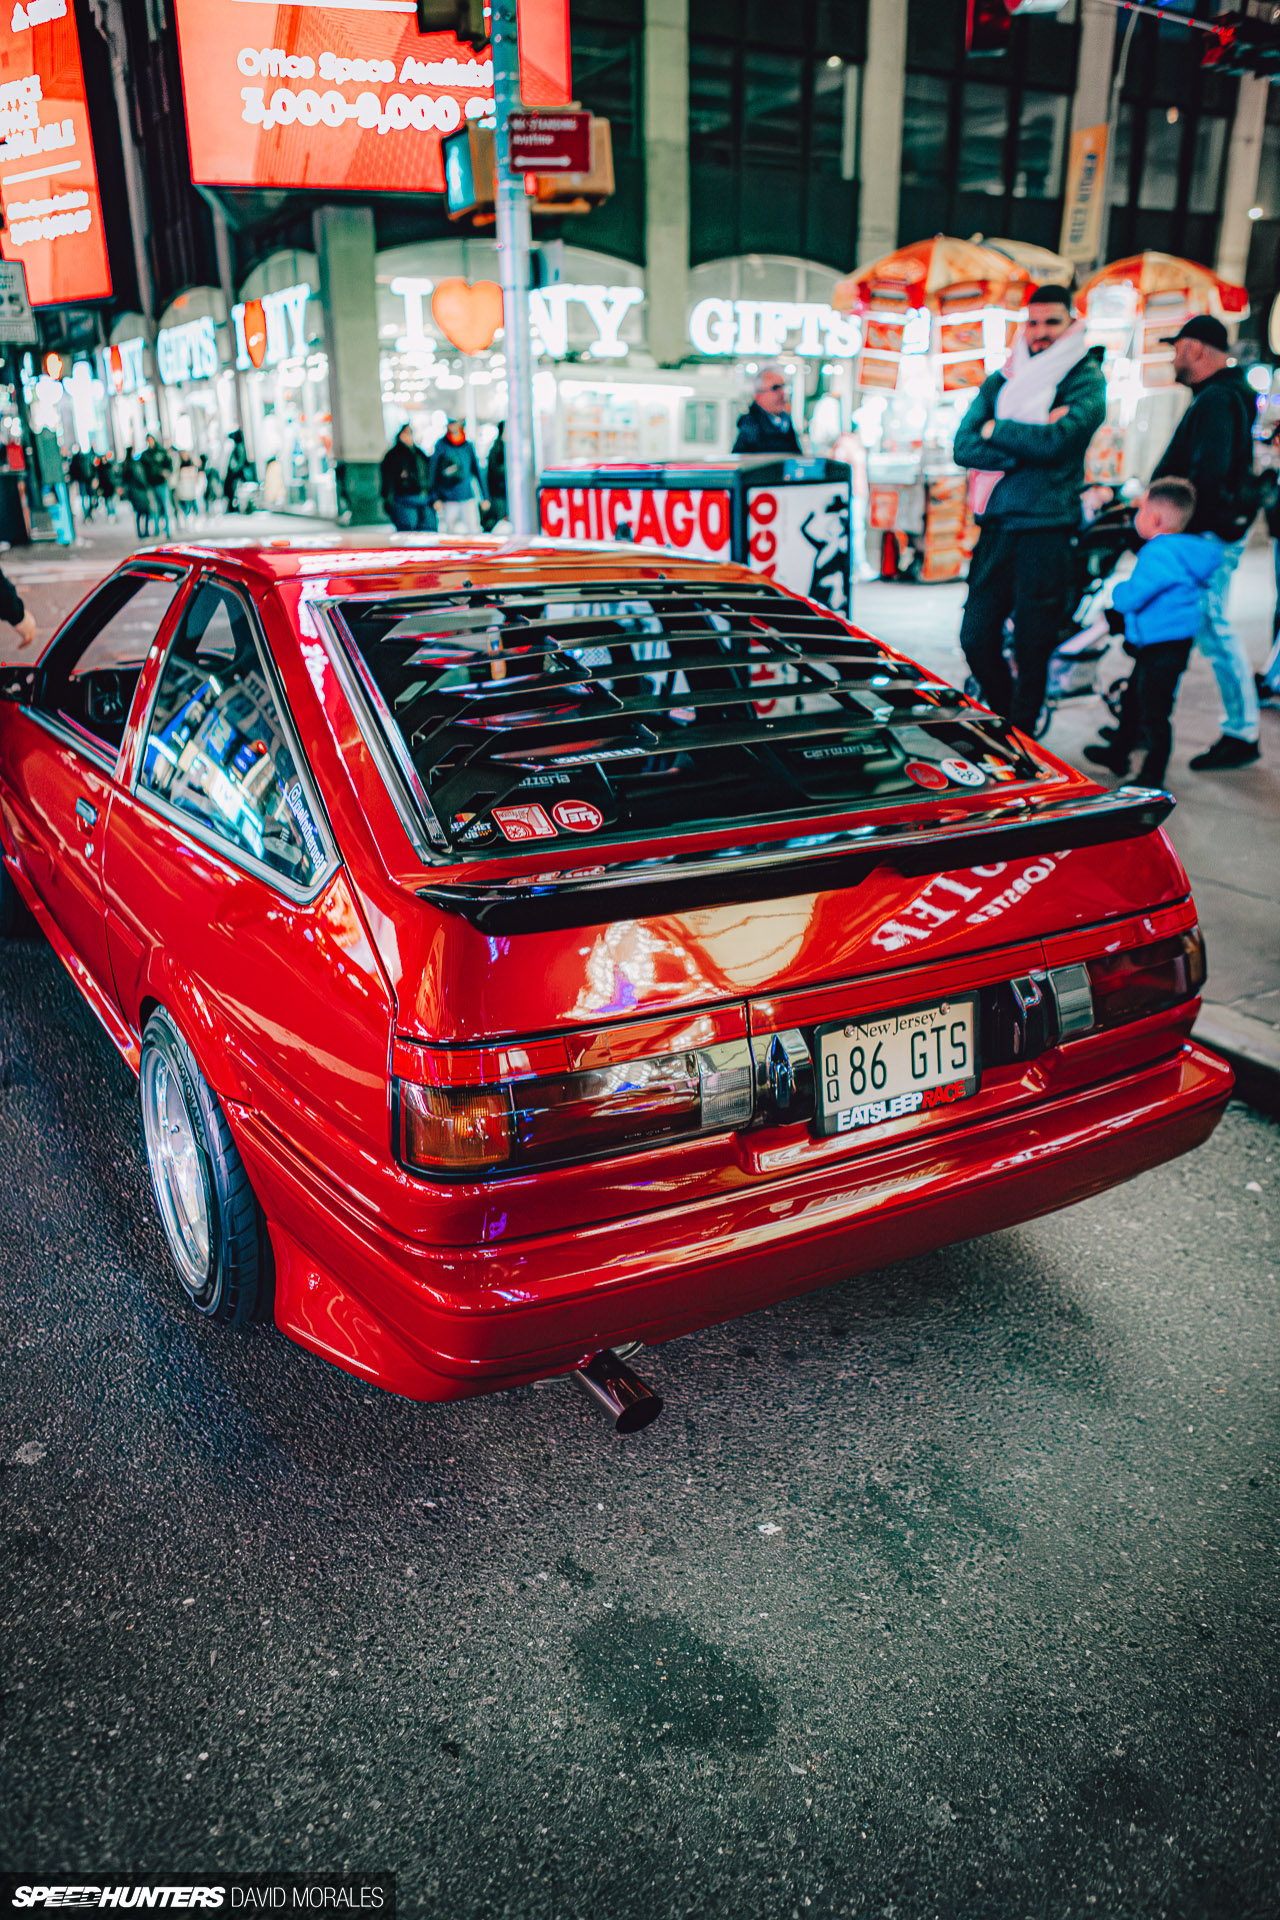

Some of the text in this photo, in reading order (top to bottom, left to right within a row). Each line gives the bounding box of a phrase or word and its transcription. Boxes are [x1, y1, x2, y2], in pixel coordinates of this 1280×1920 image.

[157, 315, 219, 386] GIFTS
[689, 298, 863, 358] GIFTS
[540, 488, 732, 551] CHICAGO
[856, 1011, 938, 1041] New Jersey
[850, 1020, 967, 1096] 86 GTS
